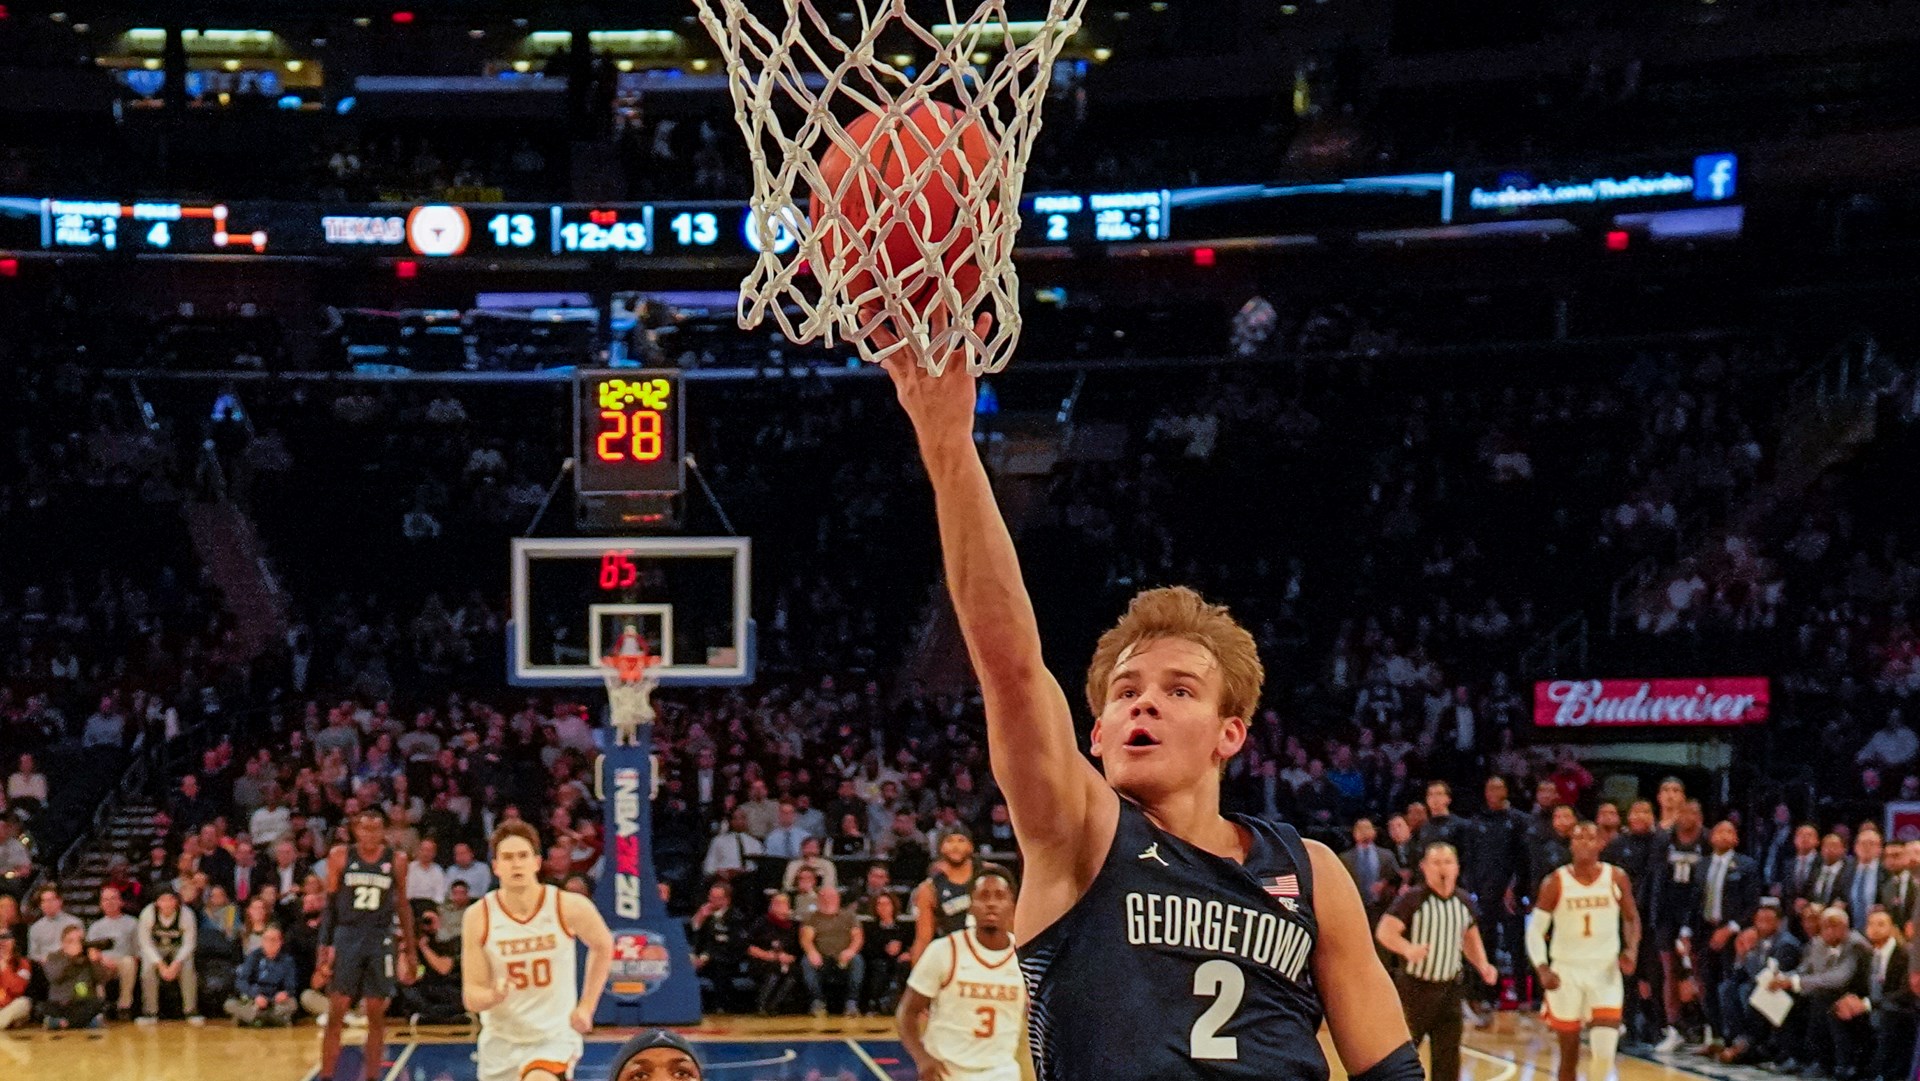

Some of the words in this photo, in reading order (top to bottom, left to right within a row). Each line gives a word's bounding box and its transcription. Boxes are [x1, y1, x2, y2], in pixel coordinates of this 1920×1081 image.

[147, 222, 170, 247] 4
[322, 216, 405, 244] TEXAS
[488, 214, 535, 246] 13
[560, 222, 647, 251] 12:43
[672, 213, 718, 245] 13
[1047, 214, 1068, 240] 2
[599, 379, 670, 410] 12:42
[598, 411, 661, 461] 28
[1548, 679, 1755, 727] Budweiser
[353, 886, 381, 910] 23
[1126, 892, 1313, 983] GEORGETOWN
[1582, 912, 1592, 938] 1
[496, 933, 557, 956] TEXAS
[506, 958, 551, 990] 50
[957, 980, 1019, 1002] TEXAS
[974, 1005, 996, 1038] 3
[1190, 959, 1246, 1060] 2
